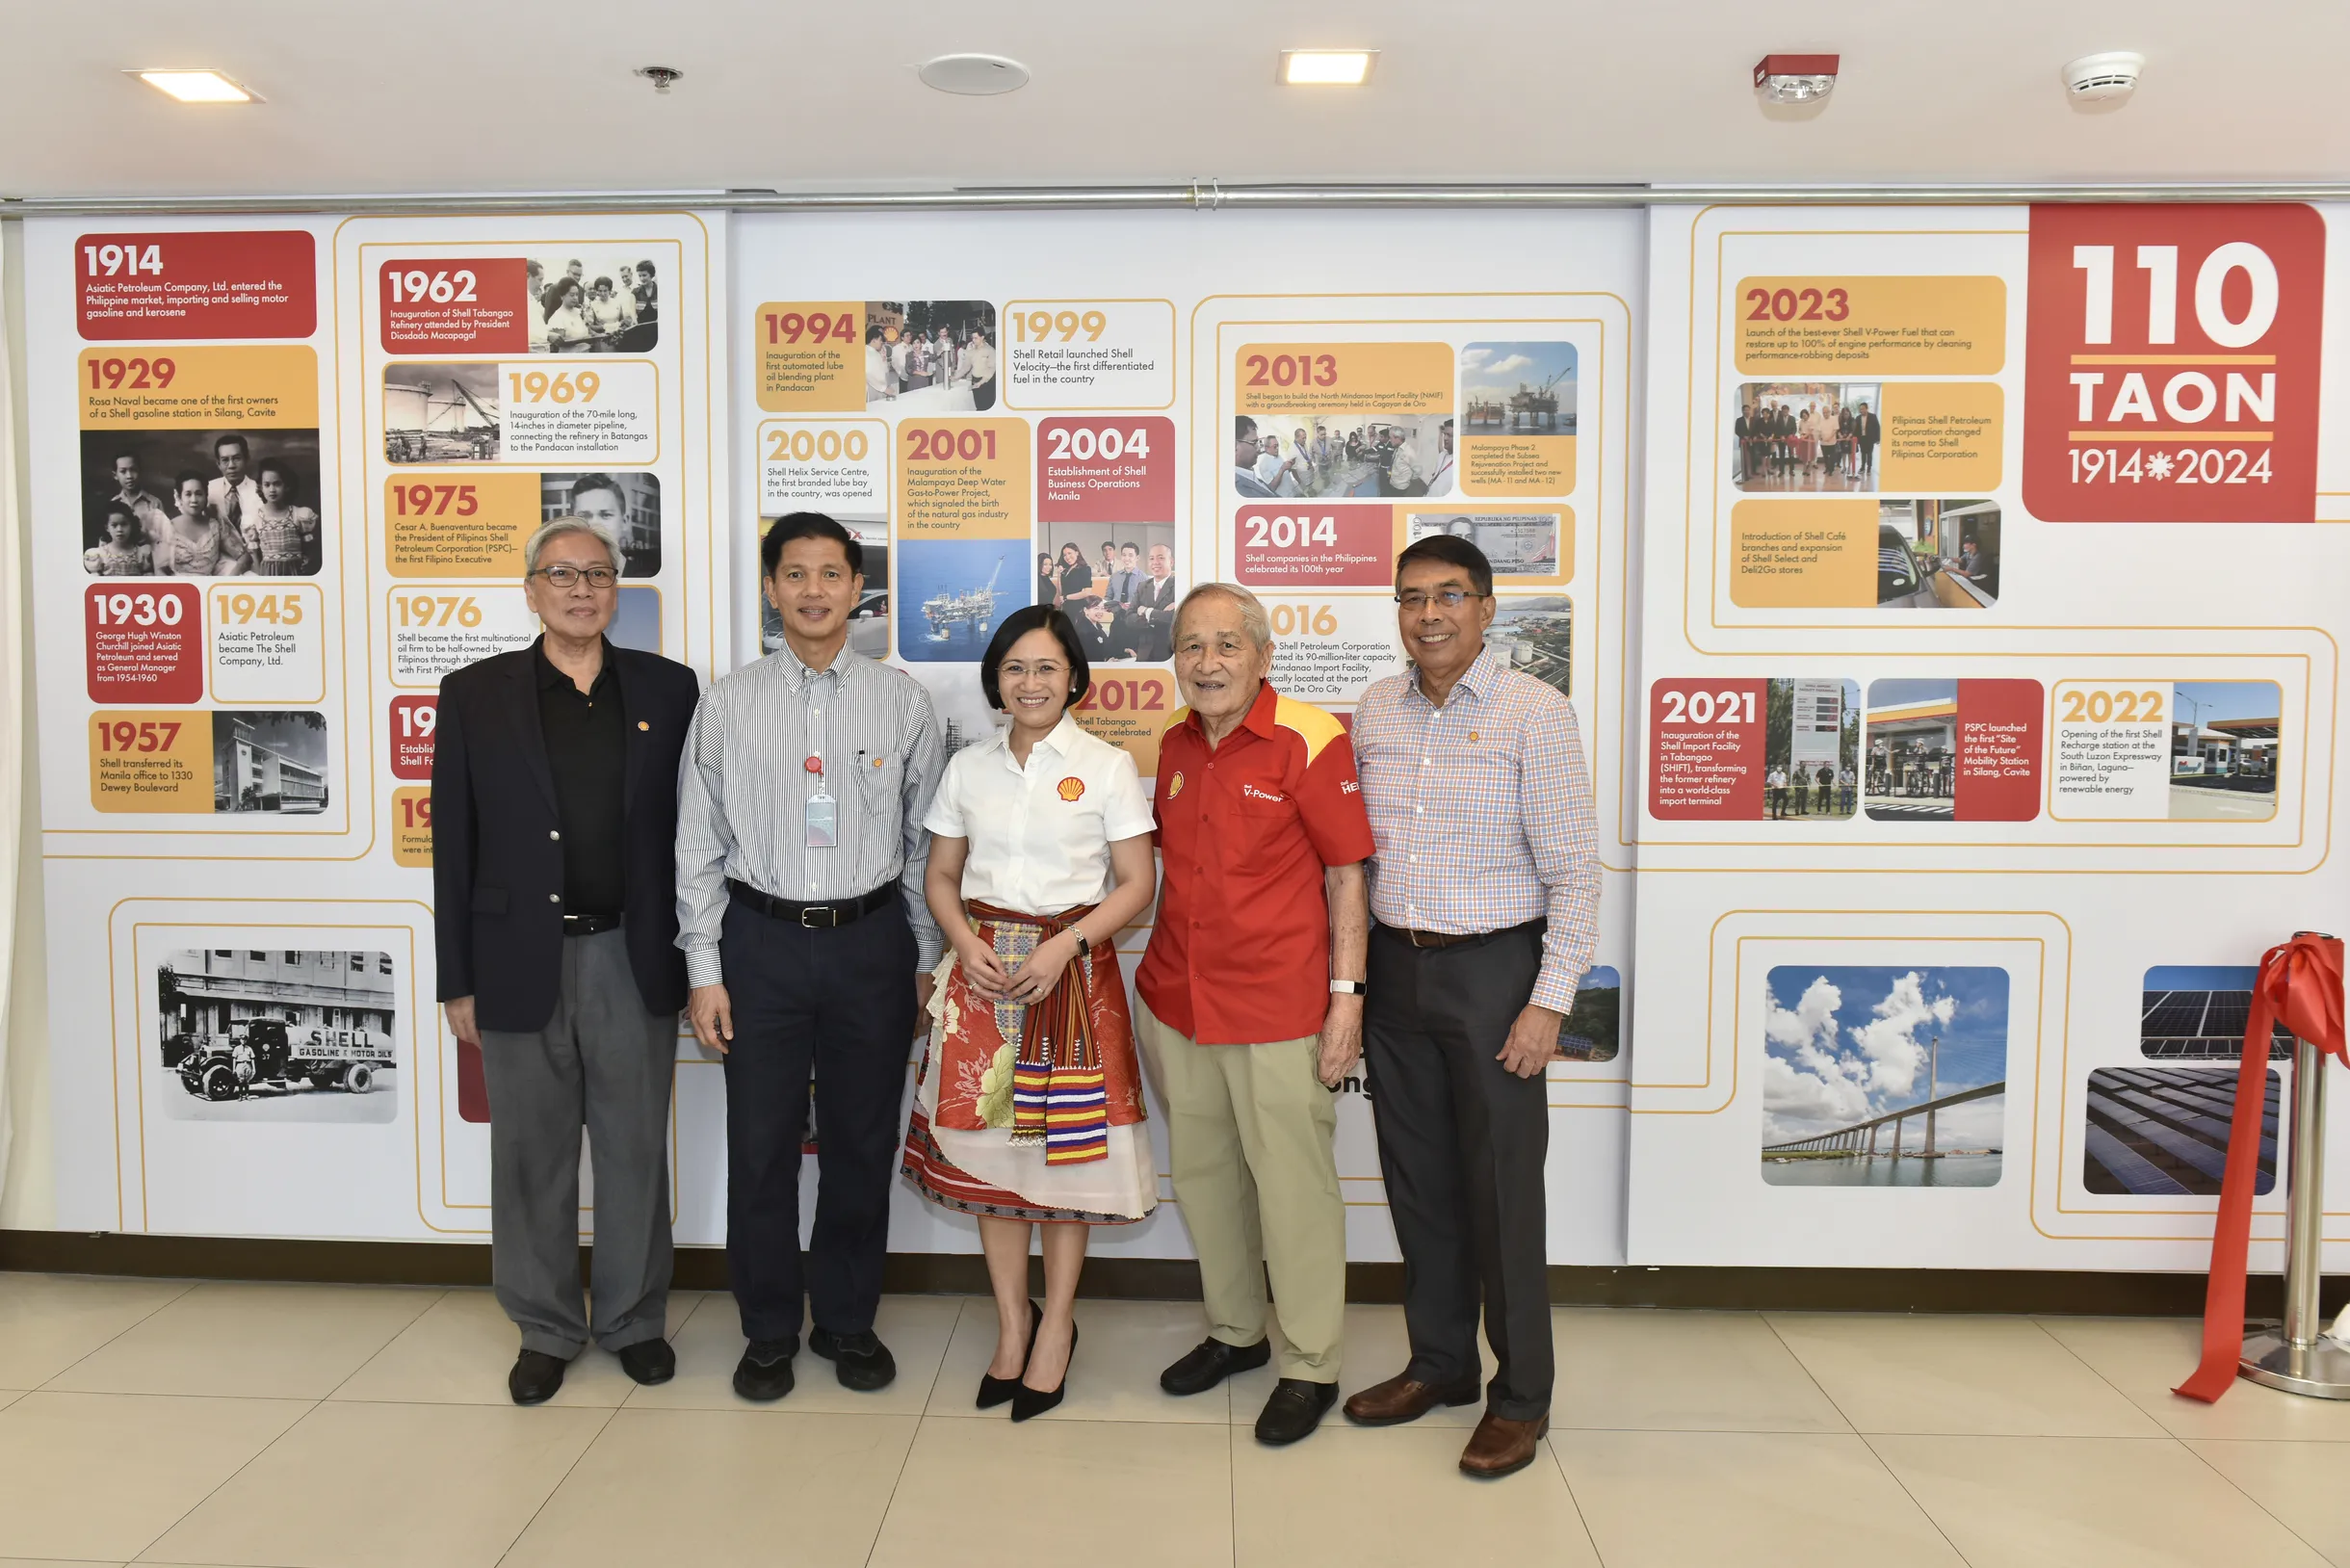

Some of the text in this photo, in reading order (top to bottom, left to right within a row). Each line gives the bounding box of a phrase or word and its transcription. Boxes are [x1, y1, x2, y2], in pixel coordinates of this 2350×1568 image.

[85, 245, 163, 275] 1914
[85, 281, 282, 295] Asiatic Petroleum Company, Ltd. entered the
[389, 270, 477, 302] 1962
[2074, 242, 2279, 348] 110
[1746, 288, 1849, 321] 2023
[390, 308, 513, 321] Inauguration of Shell Tabangao
[868, 314, 896, 325] PLANT
[765, 313, 856, 344] 1994
[1013, 311, 1106, 342] 1999
[389, 330, 476, 342] Diosdado Macapagal
[766, 350, 840, 362] Inauguration of the
[1013, 349, 1133, 359] Shell Retail launched Shell
[1745, 351, 1868, 361] performance-robbing deposits
[1073, 361, 1090, 372] first
[1092, 360, 1154, 371] differentiated
[1246, 354, 1337, 386] 2013
[88, 358, 175, 389] 1929
[509, 372, 600, 404] 1969
[89, 397, 110, 406] Rosa
[113, 397, 141, 405] Naval
[143, 396, 178, 405] became
[199, 396, 209, 405] of
[211, 396, 224, 405] the
[227, 395, 244, 405] first
[2070, 372, 2276, 423] TAON
[509, 409, 637, 421] Inauguration of the 70-mile long,
[1892, 416, 1991, 427] Pilipinas Shell Petroleum
[768, 430, 868, 460] 2000
[907, 430, 996, 460] 2001
[1048, 428, 1149, 459] 2004
[1048, 465, 1146, 476] Establishment of Shell
[2069, 448, 2272, 483] 1914 2024
[768, 467, 869, 478] Shell Helix Service Centre,
[906, 477, 1005, 488] Malampaya Deep Water
[1048, 478, 1140, 491] Business Operations
[906, 487, 990, 499] Gas-to-Power Project,
[1048, 490, 1080, 501] Manila
[394, 484, 478, 516] 1975
[1245, 516, 1337, 547] 2014
[1741, 532, 1845, 540] Introduction of Shell Café
[395, 544, 433, 553] Petroleum
[435, 545, 483, 555] Corporation
[1245, 553, 1265, 562] Shell
[1266, 554, 1309, 564] companies
[1319, 553, 1333, 562] the
[1335, 553, 1376, 564] Philippines
[94, 594, 182, 625] 1930
[217, 594, 302, 624] 1945
[396, 596, 482, 627] 1976
[1270, 604, 1338, 636] 016
[95, 632, 125, 642] George
[127, 631, 148, 642] Hugh
[218, 632, 294, 641] Asiatic Petroleum
[397, 634, 531, 642] Shell became the first multinational
[95, 641, 181, 653] Churchill joined Asiatic
[219, 644, 296, 653] became The Shell
[1279, 641, 1390, 652] Shell Petroleum Corporation
[219, 656, 282, 667] Company, Ltd.
[1270, 663, 1371, 673] Mindanao Import Facility,
[1075, 680, 1163, 711] 2012
[1661, 692, 1755, 723] 2021
[2061, 691, 2163, 722] 2022
[1096, 718, 1136, 727] Tabangao
[1965, 723, 2026, 732] PSPC launched
[98, 721, 182, 751] 1957
[2061, 730, 2098, 741] Opening
[2110, 730, 2123, 739] the
[2125, 730, 2140, 739] first
[2142, 730, 2162, 739] Shell
[1660, 742, 1740, 752] Shell Import Facility
[1963, 756, 1998, 767] Mobility
[2060, 751, 2084, 760] South
[2113, 752, 2161, 763] Expressway
[1660, 764, 1746, 774] (SHIFT), transforming
[100, 771, 193, 780] Manila office to 1330
[100, 783, 178, 795] Dewey Boulevard
[1243, 789, 1284, 802] V-Power
[310, 1030, 374, 1048] SHELL
[300, 1048, 339, 1057] GASOLINE
